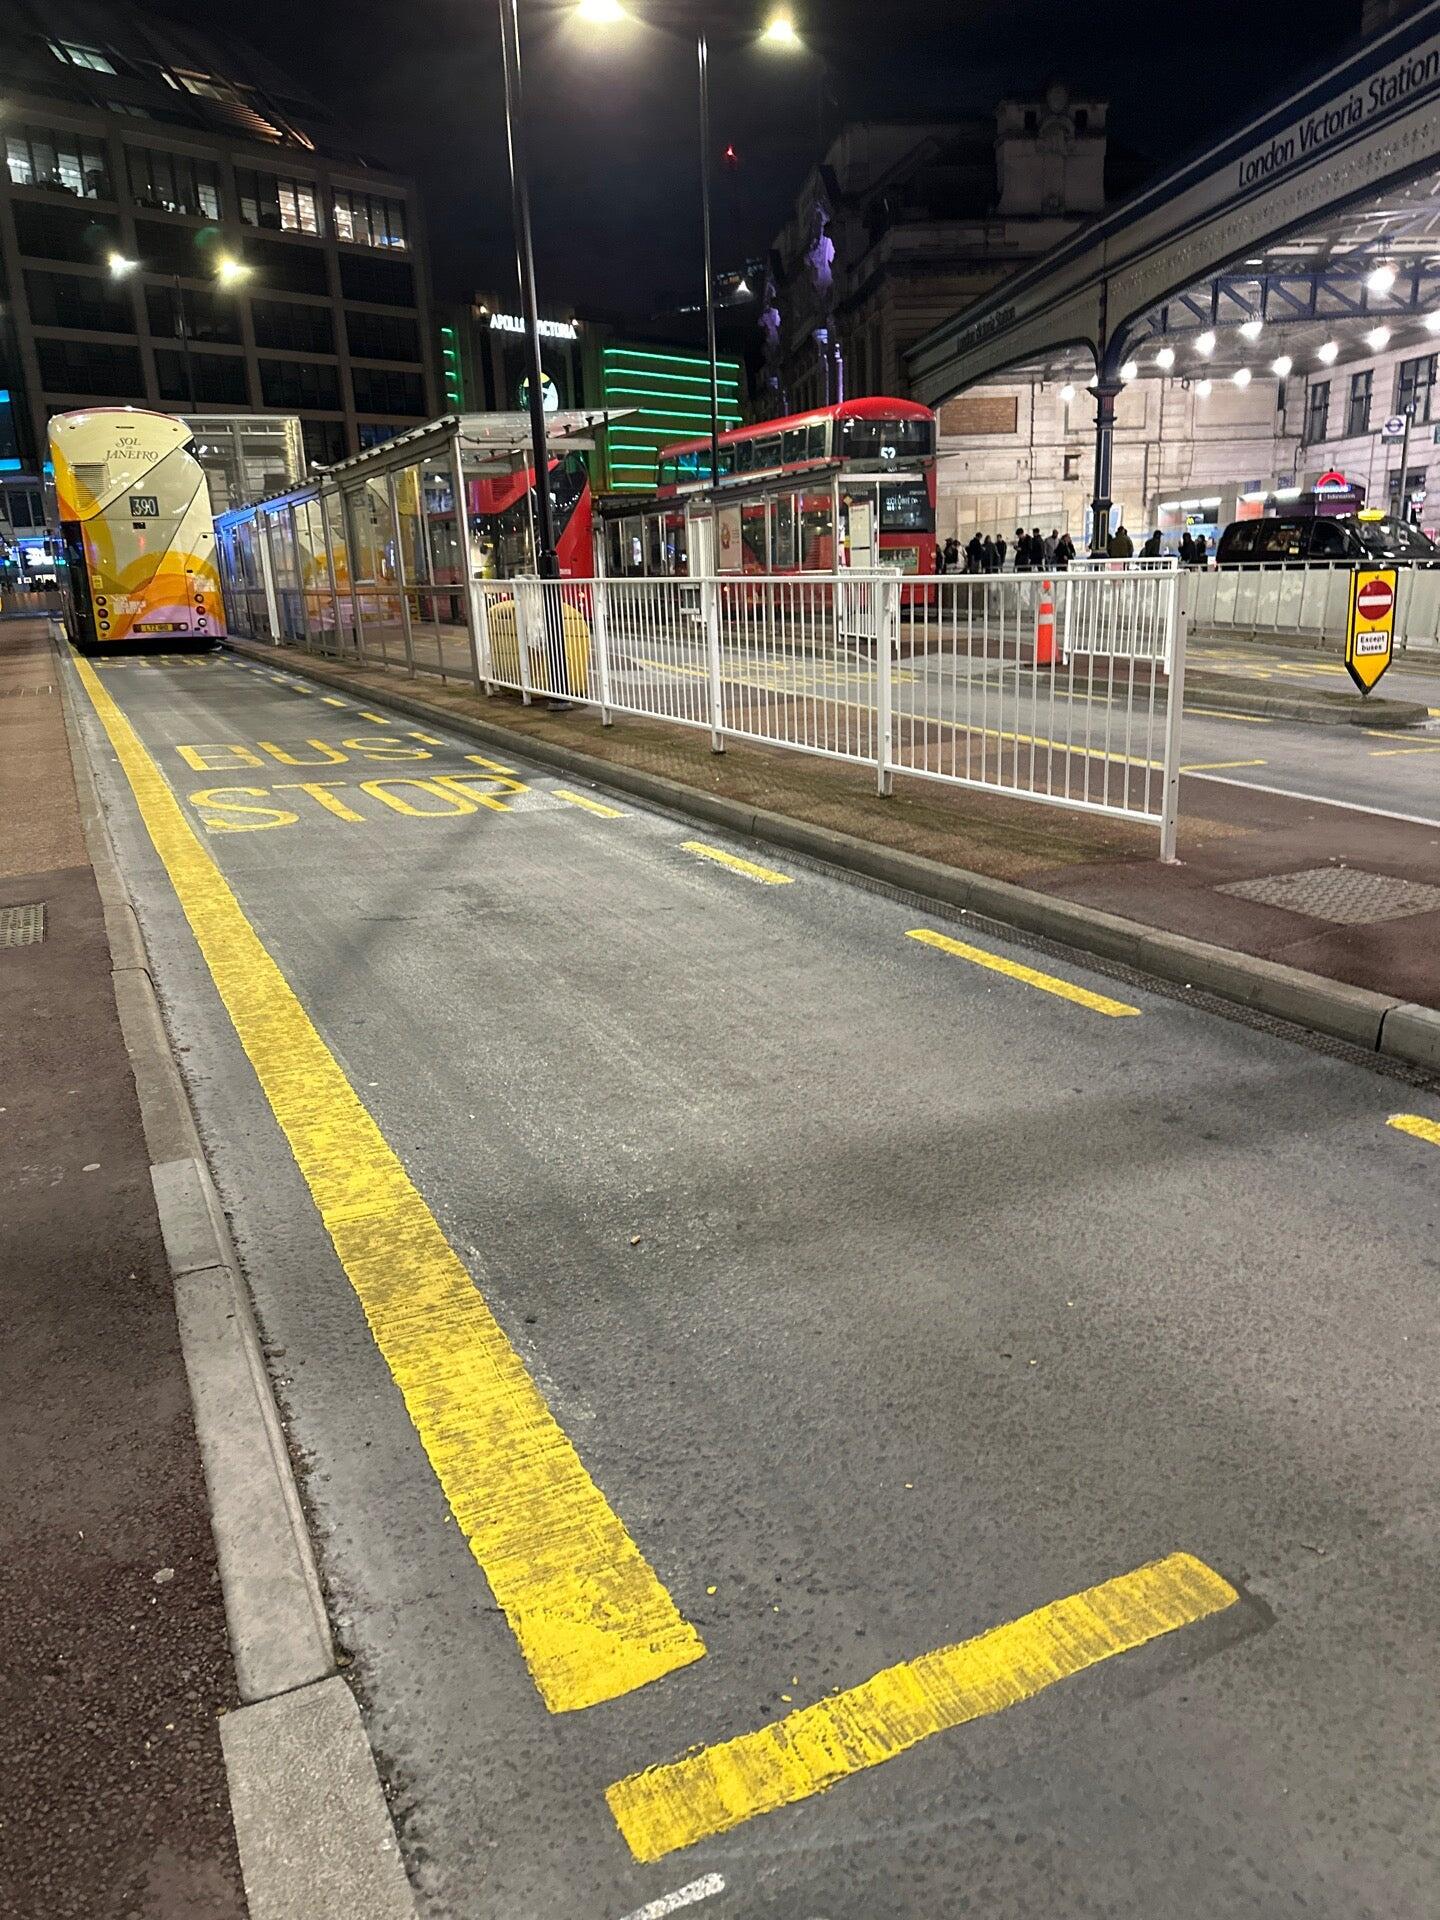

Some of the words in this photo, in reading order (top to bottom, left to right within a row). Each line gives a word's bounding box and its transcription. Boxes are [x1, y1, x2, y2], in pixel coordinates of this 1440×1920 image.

[1238, 137, 1295, 188] London
[1299, 95, 1362, 152] Victoria
[1367, 50, 1440, 114] Station
[490, 314, 525, 333] APOLL
[115, 437, 141, 447] SOL
[104, 450, 158, 462] JANEIRO
[132, 498, 156, 515] 390
[1360, 634, 1385, 644] Except
[1361, 644, 1382, 652] buses
[175, 737, 433, 772] BUS
[188, 774, 531, 832] STOP
